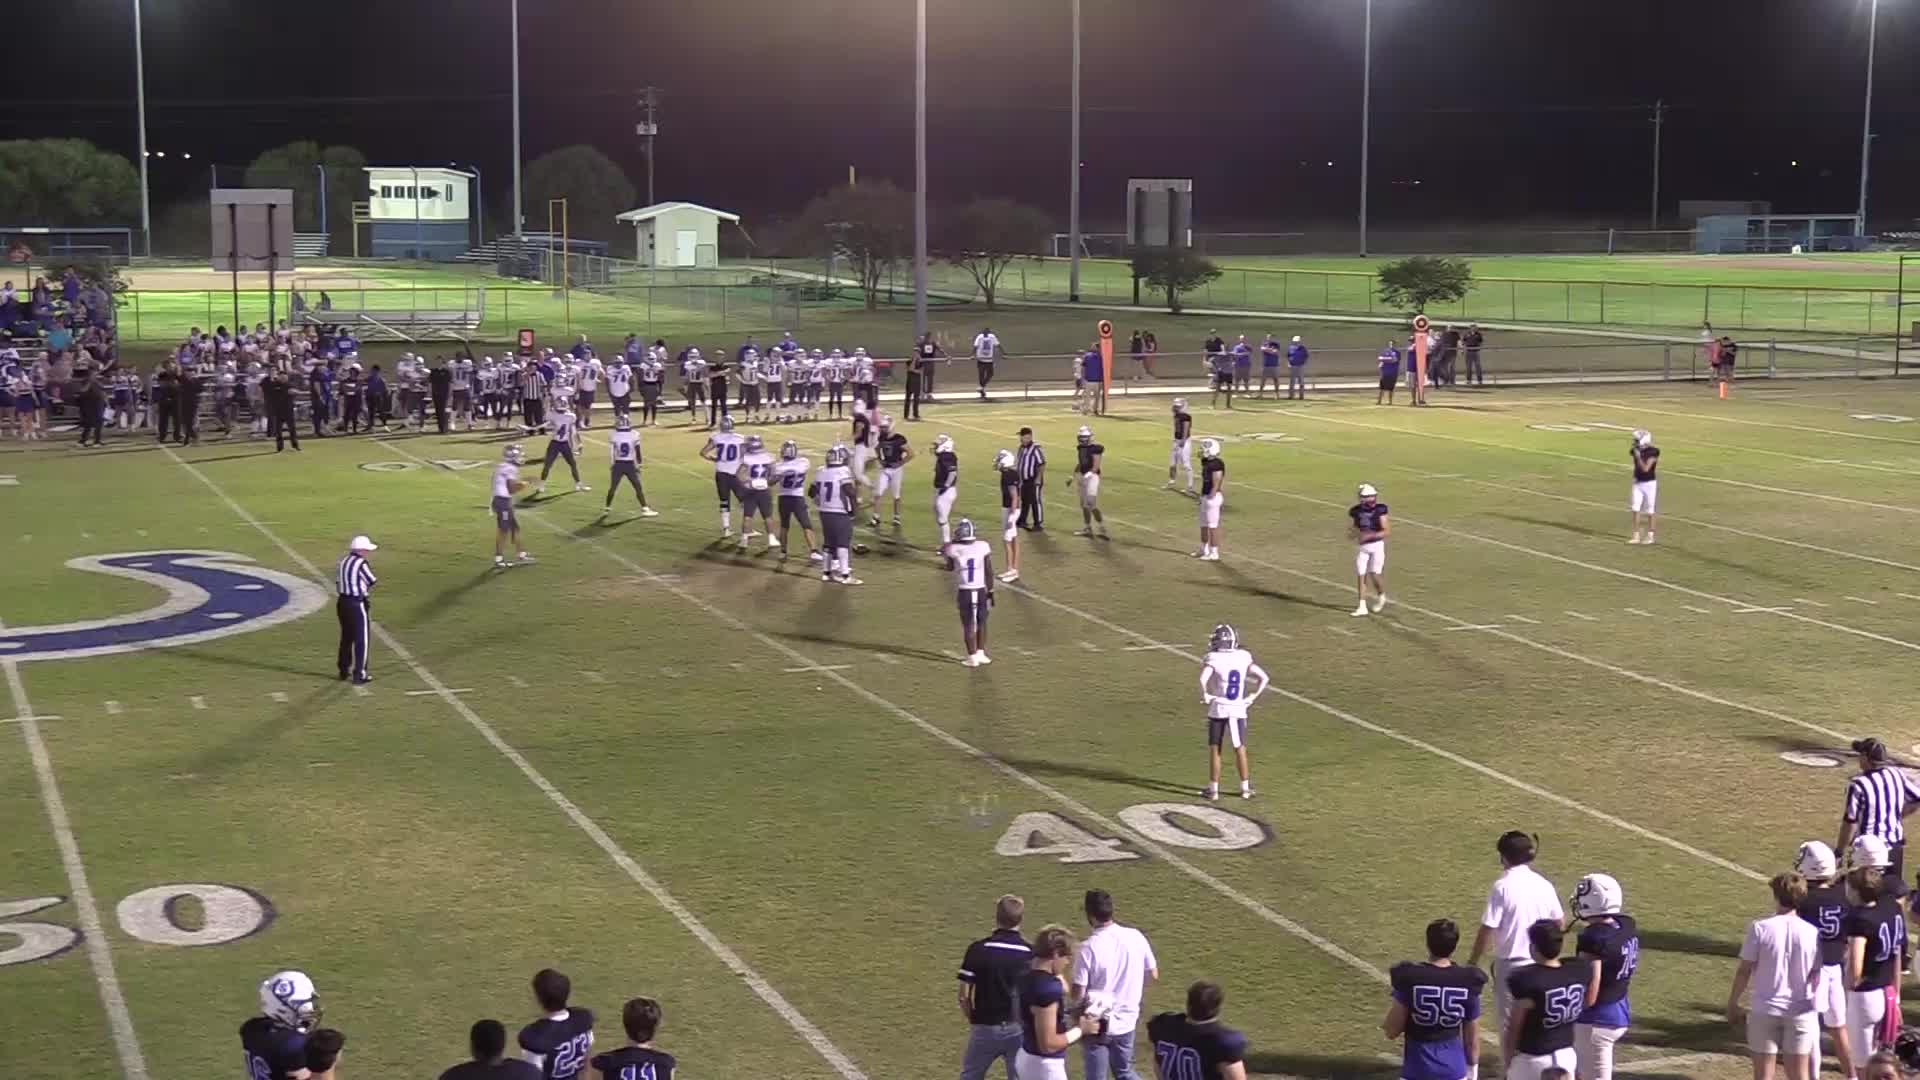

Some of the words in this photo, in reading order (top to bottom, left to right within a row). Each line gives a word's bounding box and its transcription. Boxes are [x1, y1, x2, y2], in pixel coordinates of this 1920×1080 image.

[715, 443, 738, 461] 70
[966, 558, 976, 583] 1
[1226, 669, 1241, 700] 8
[994, 802, 1274, 864] 40
[1411, 985, 1469, 1028] 55
[1543, 983, 1585, 1028] 52
